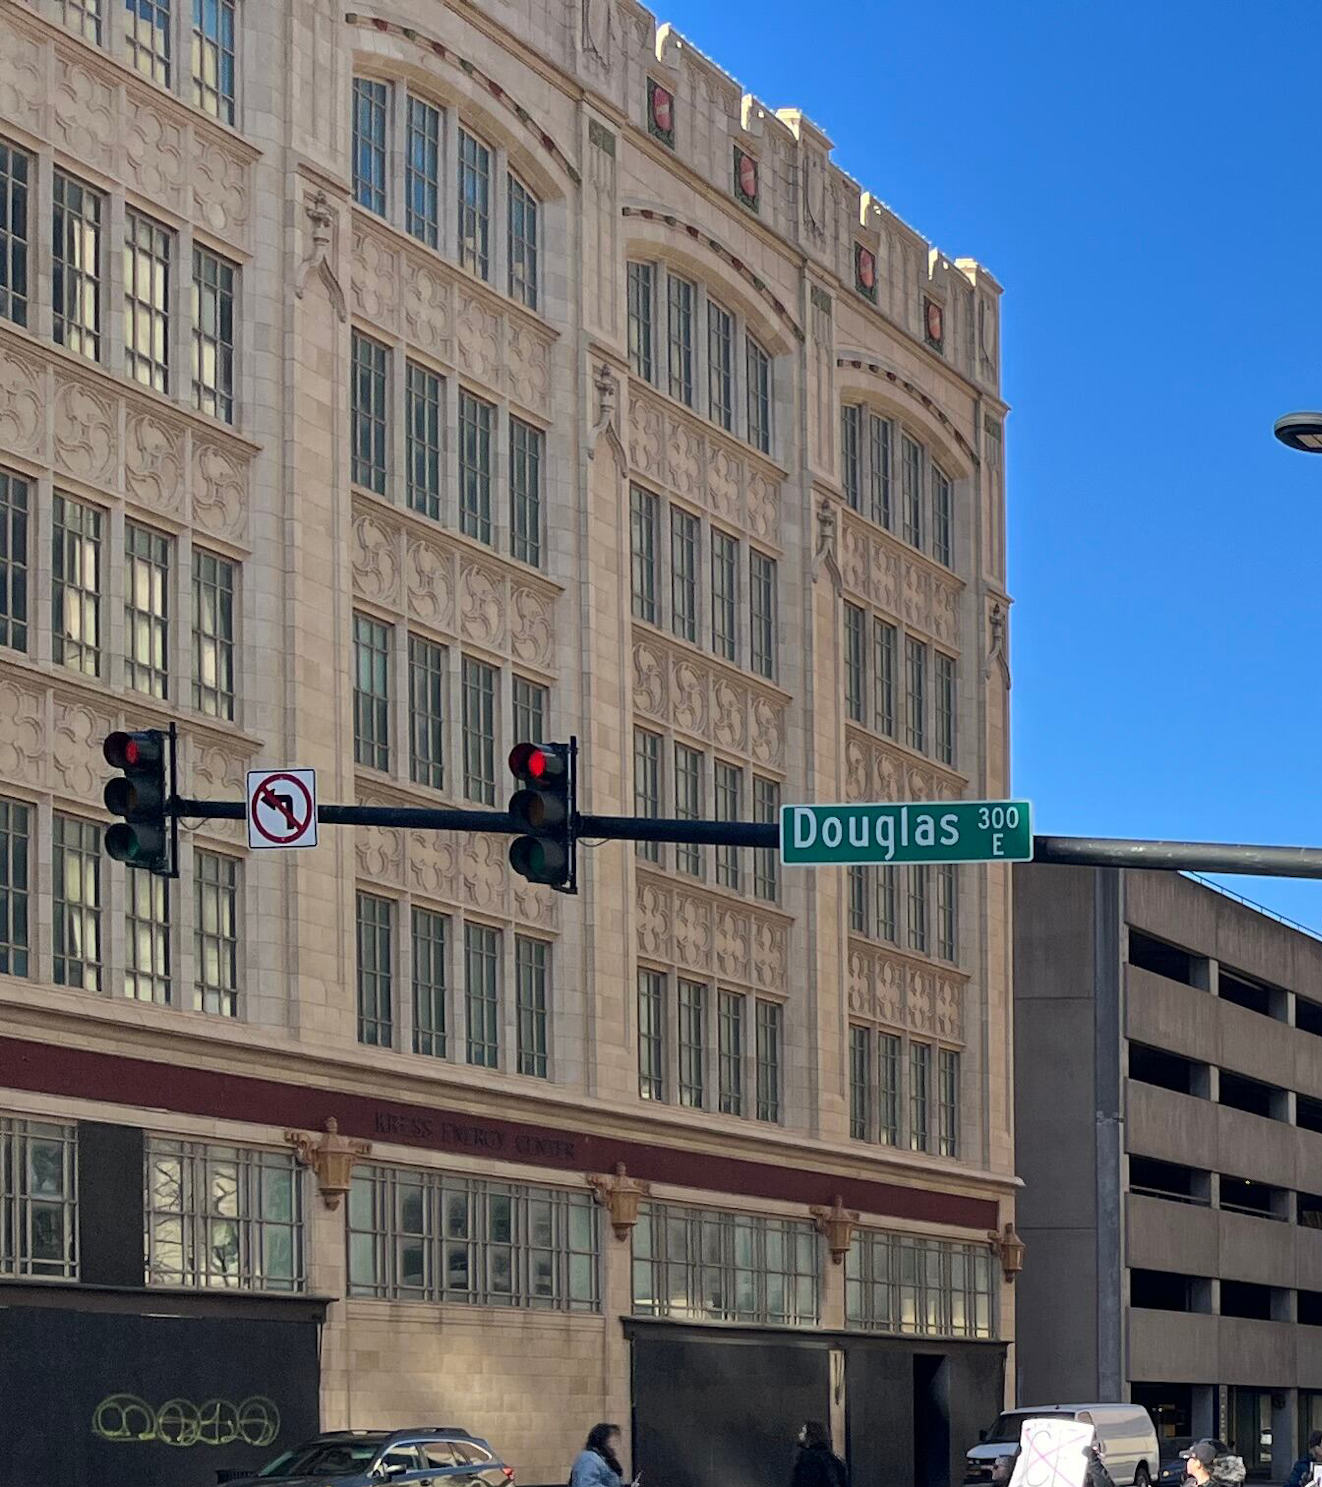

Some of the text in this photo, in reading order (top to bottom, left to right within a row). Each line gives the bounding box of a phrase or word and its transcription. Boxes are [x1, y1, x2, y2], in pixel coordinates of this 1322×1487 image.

[977, 806, 1020, 830] 300
[793, 806, 960, 861] Douglas
[992, 833, 1005, 856] E
